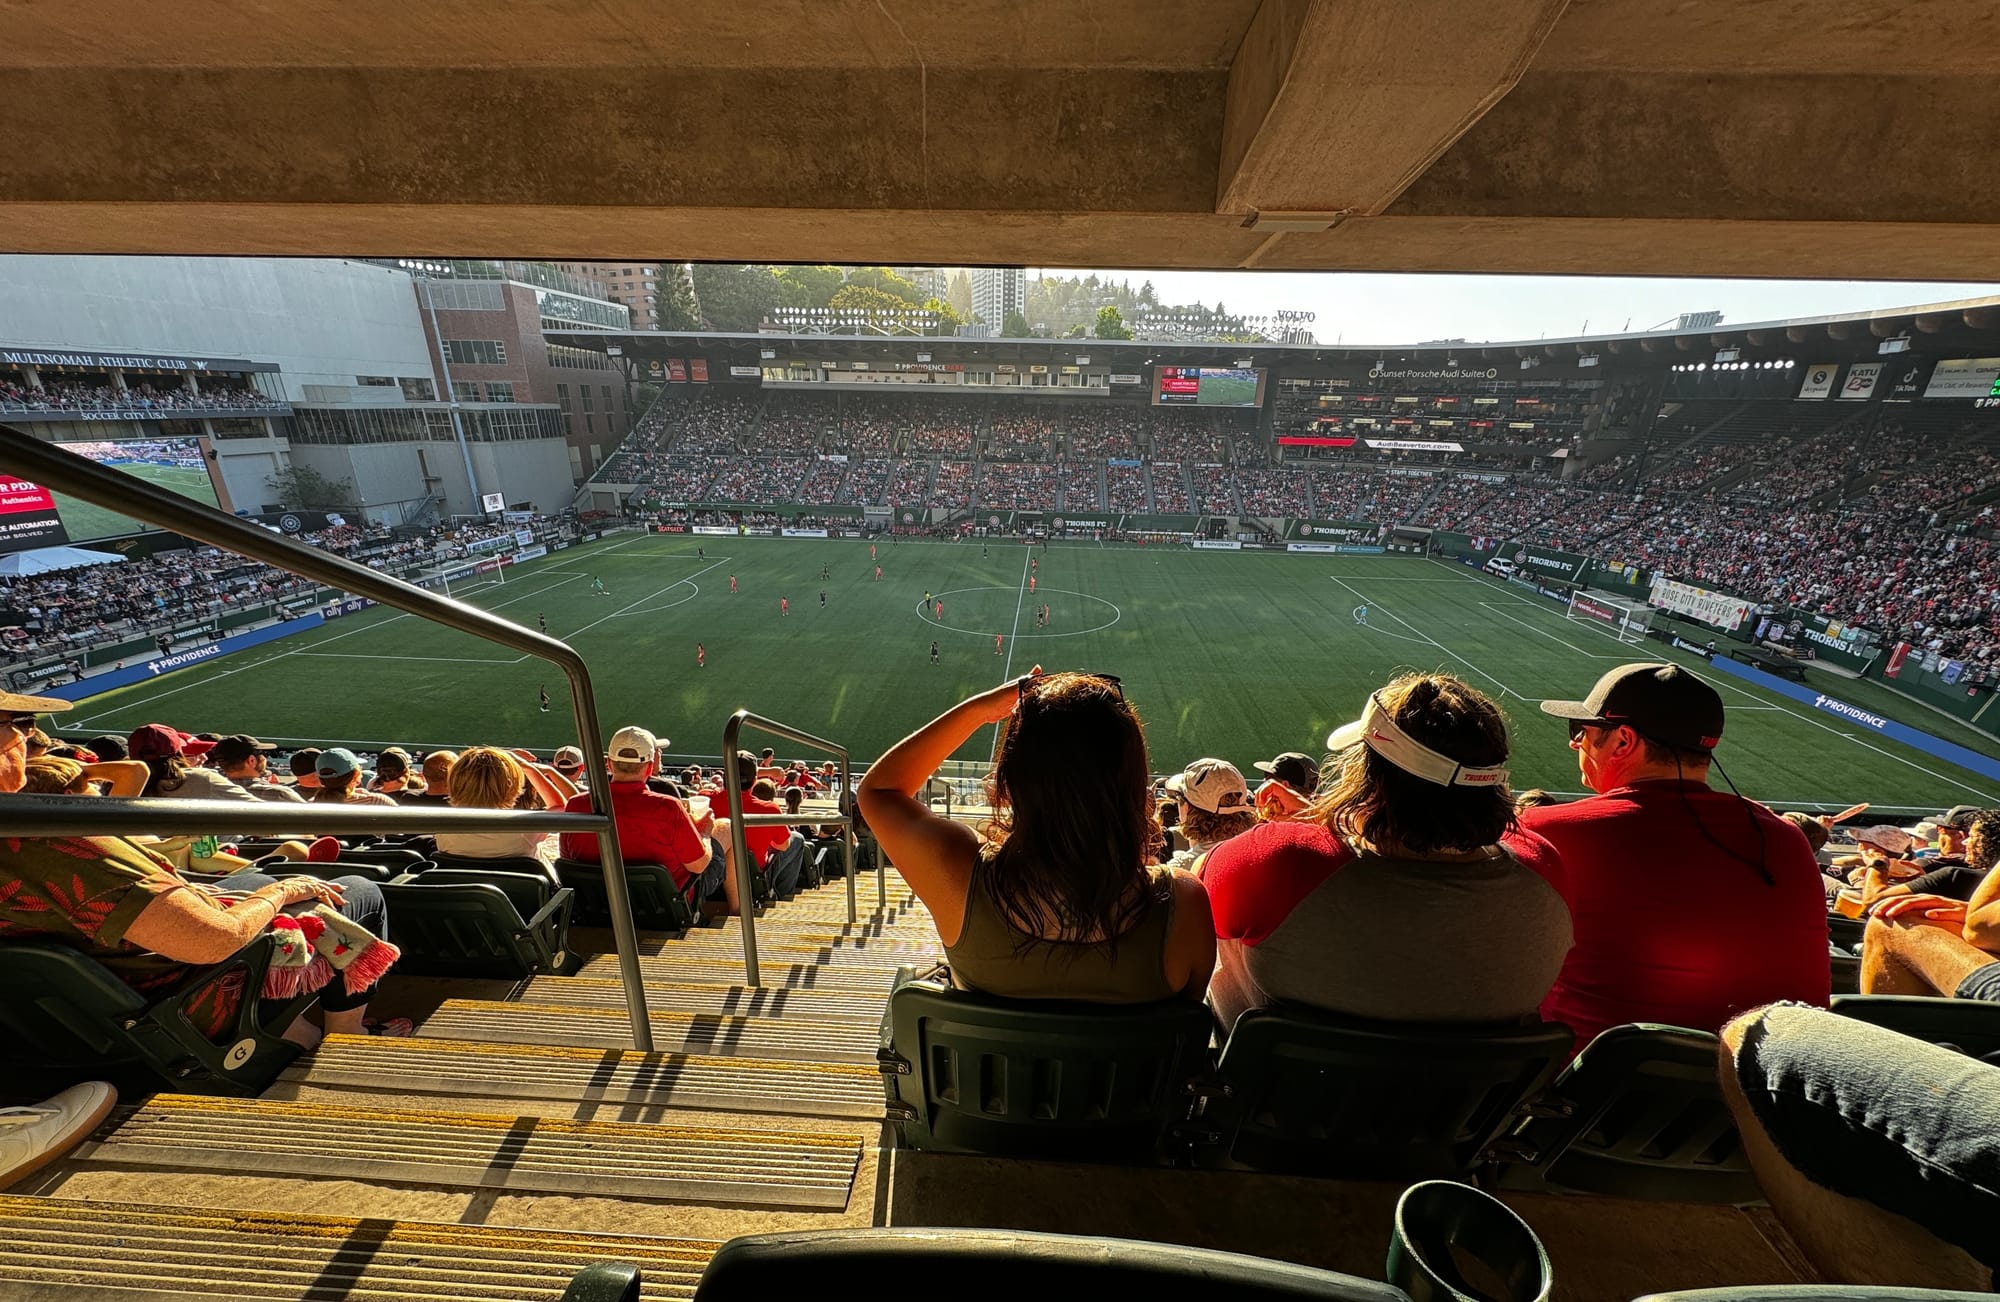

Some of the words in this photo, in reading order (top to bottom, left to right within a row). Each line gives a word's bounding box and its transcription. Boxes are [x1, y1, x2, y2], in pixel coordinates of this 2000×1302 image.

[1277, 309, 1316, 323] VOLVO
[2, 352, 95, 366] MULTNOMAH
[98, 356, 154, 368] ATHLETIC
[157, 359, 187, 369] CLUB
[1379, 369, 1405, 378] Sunset
[1407, 369, 1439, 378] Porsche
[1440, 369, 1460, 378] Audi
[1460, 369, 1486, 378] Suites
[1850, 368, 1878, 377] KATU
[81, 412, 121, 421] SOCCER
[123, 412, 145, 420] CITY
[148, 411, 168, 420] USA
[1376, 441, 1451, 450] AudiBeaverton.com
[10, 481, 38, 491] PDX
[2, 495, 44, 505] Authentics
[9, 519, 60, 531] AUTOMATION
[1313, 527, 1346, 535] THORNS
[13, 530, 44, 538] SOLVED
[1527, 555, 1560, 569] THORNS
[1560, 562, 1573, 572] FC
[347, 600, 362, 611] ally
[1661, 588, 1679, 601] ROSE
[1680, 592, 1697, 607] CITY
[1696, 598, 1733, 618] RIVETERS
[326, 606, 343, 617] ally
[174, 628, 203, 640] THORNS
[202, 624, 213, 633] FC
[1804, 628, 1847, 652] THORNS
[160, 644, 221, 669] PROVIDENCE
[28, 663, 67, 678] THORNS
[1824, 698, 1887, 728] PROVIDENCE
[234, 1046, 247, 1061] G
